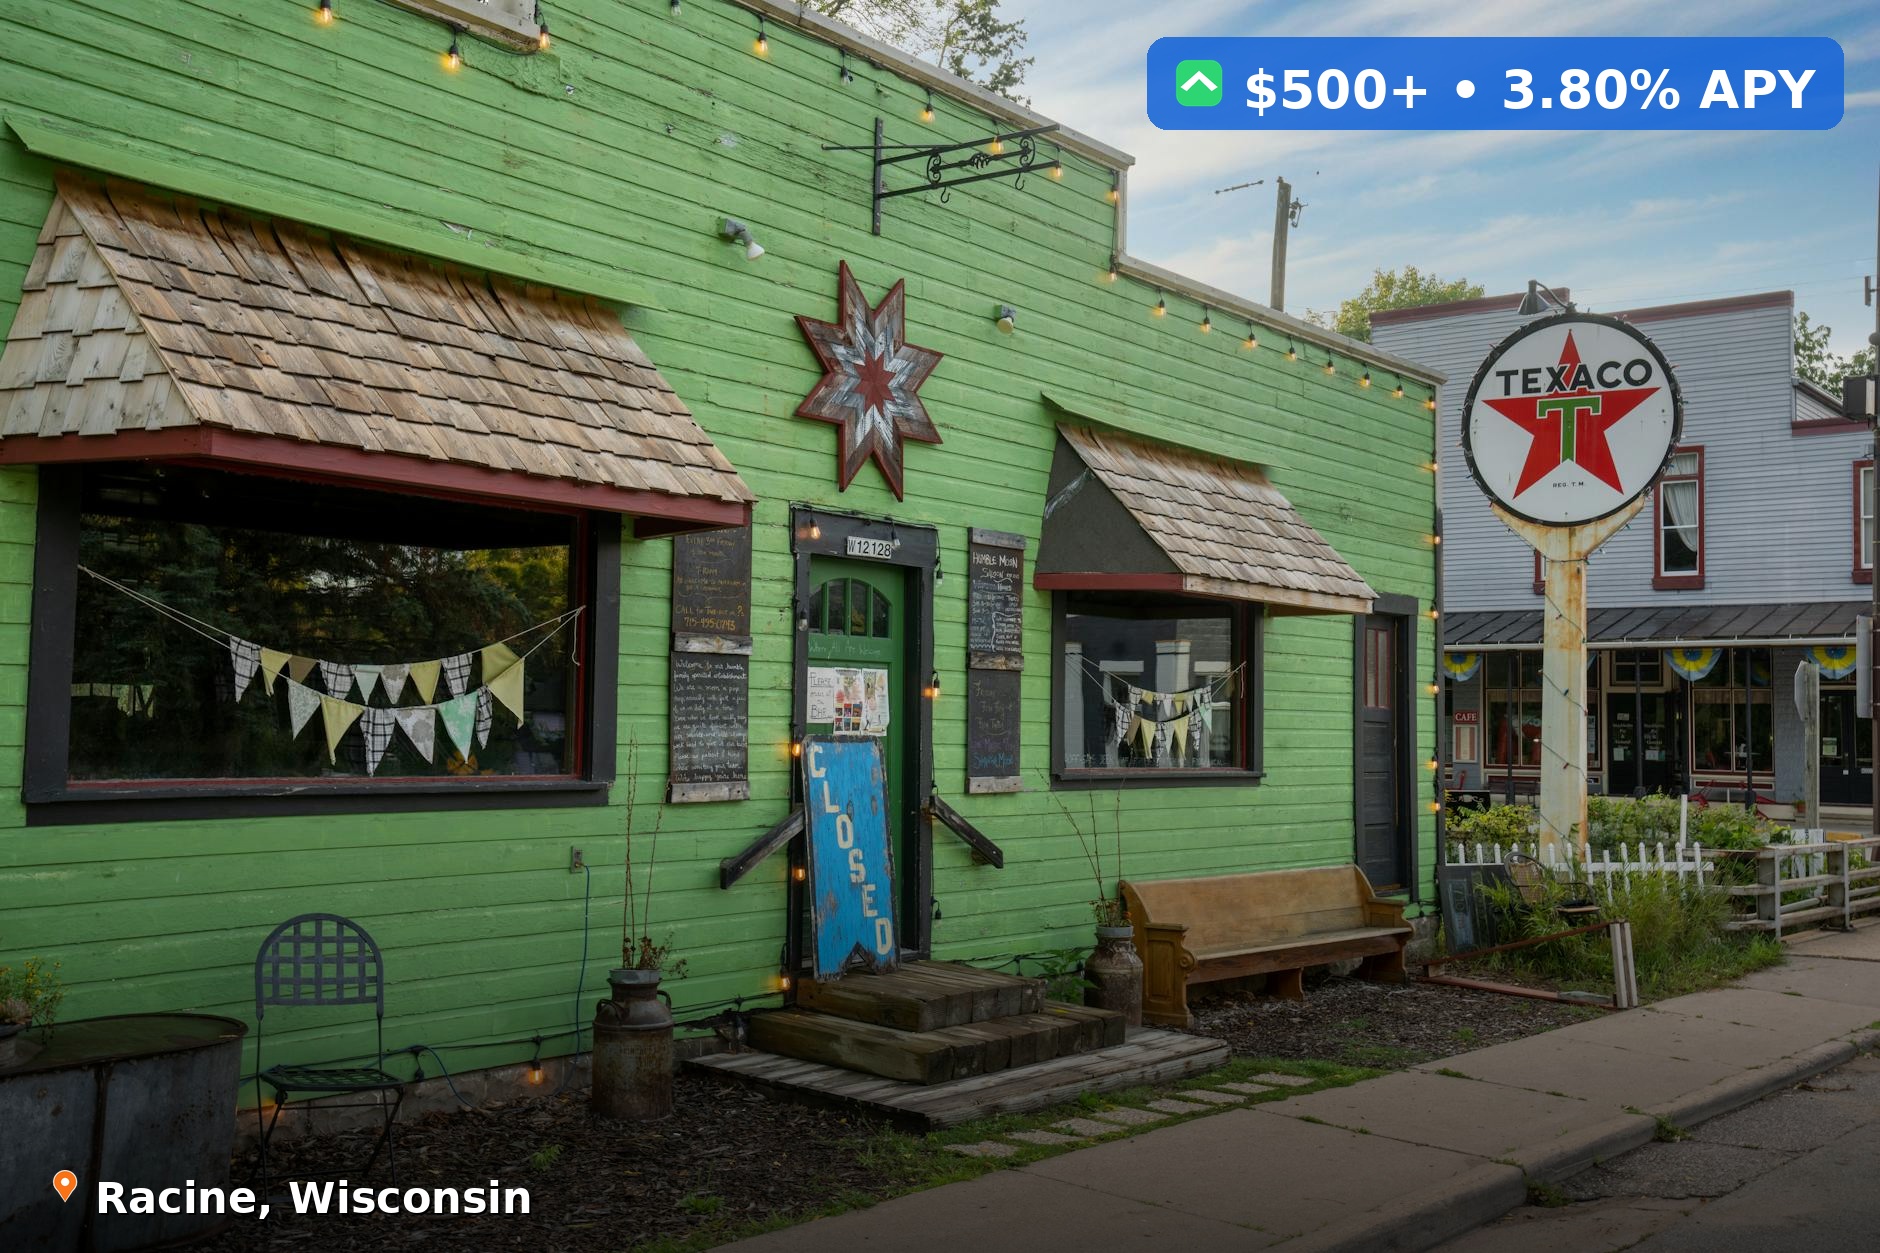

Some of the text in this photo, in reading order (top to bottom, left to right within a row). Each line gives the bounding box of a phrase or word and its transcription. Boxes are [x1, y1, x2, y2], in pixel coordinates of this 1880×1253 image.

[1495, 358, 1653, 396] TEXACO
[1536, 395, 1603, 464] T
[999, 555, 1018, 568] MOON
[1455, 713, 1477, 721] CAFE
[809, 743, 893, 956] CLOSED
